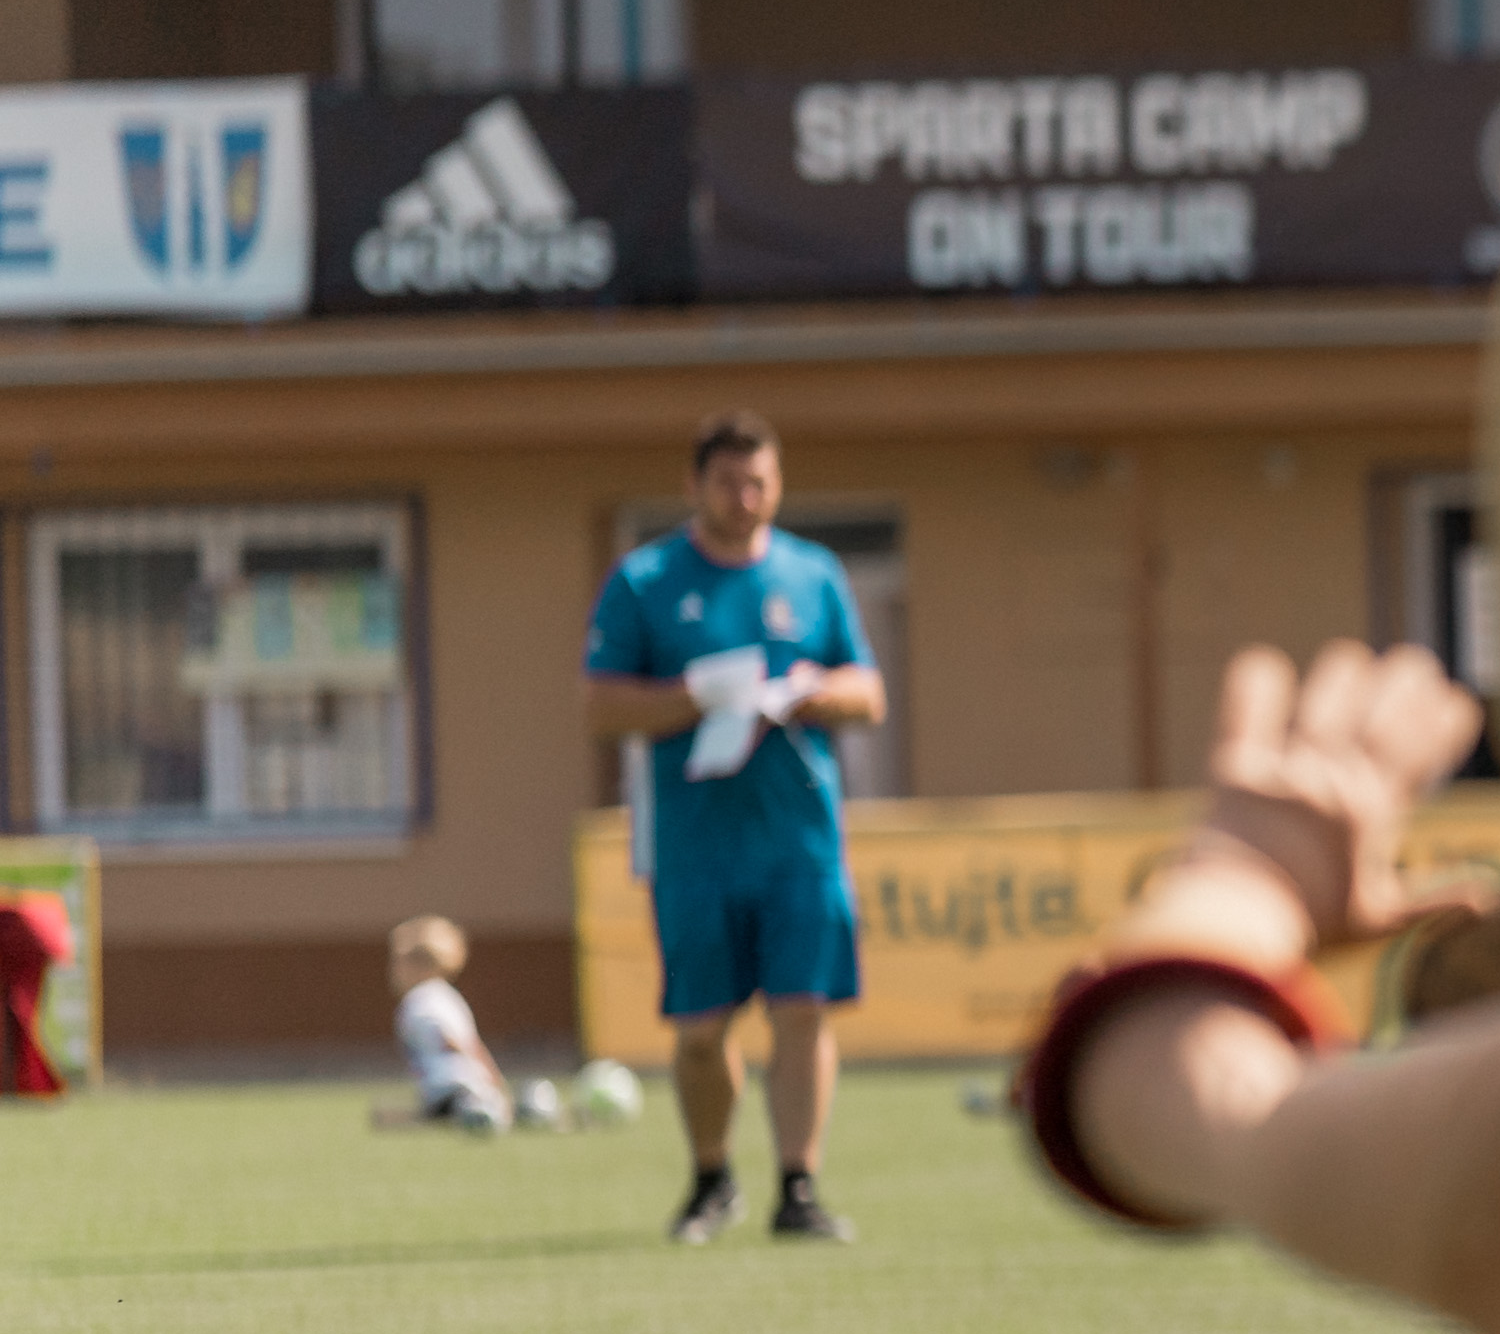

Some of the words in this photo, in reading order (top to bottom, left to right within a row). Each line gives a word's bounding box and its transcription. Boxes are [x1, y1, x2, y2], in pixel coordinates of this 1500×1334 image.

[795, 75, 1120, 184] SPARTA
[1129, 69, 1367, 173] CAMP
[353, 214, 614, 296] adidas
[907, 188, 1029, 289] ON
[1034, 180, 1254, 285] TOUR
